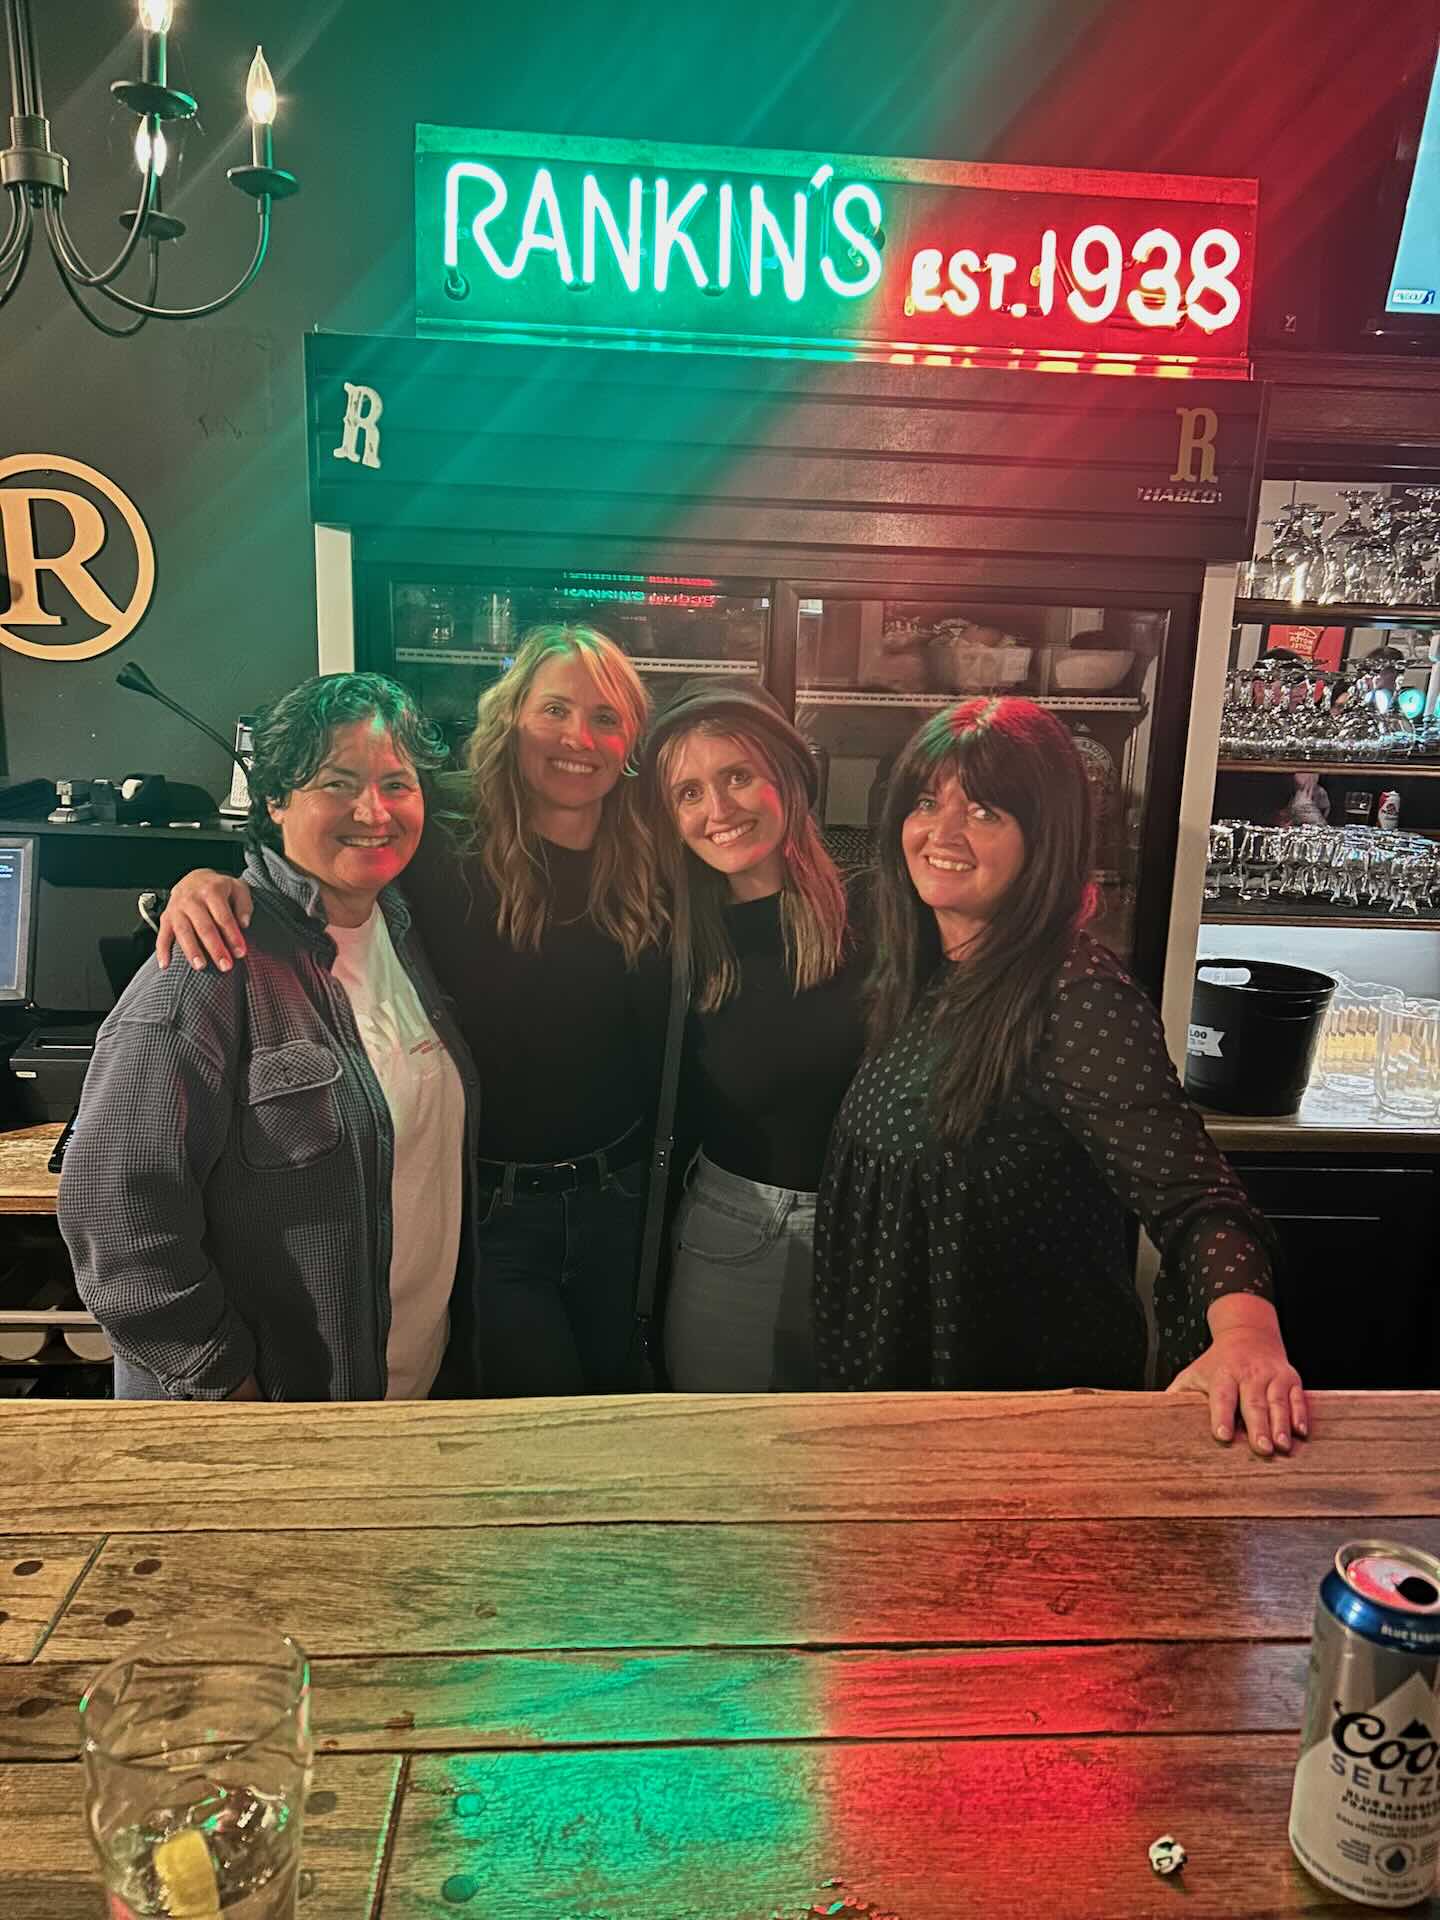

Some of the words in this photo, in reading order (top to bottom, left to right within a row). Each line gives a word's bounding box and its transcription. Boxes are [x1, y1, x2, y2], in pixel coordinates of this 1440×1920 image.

[445, 161, 883, 302] RANKIN'S
[333, 382, 384, 469] R
[1169, 407, 1219, 483] R
[1330, 1752, 1440, 1798] SELTZ
[1332, 1699, 1440, 1775] Coo
